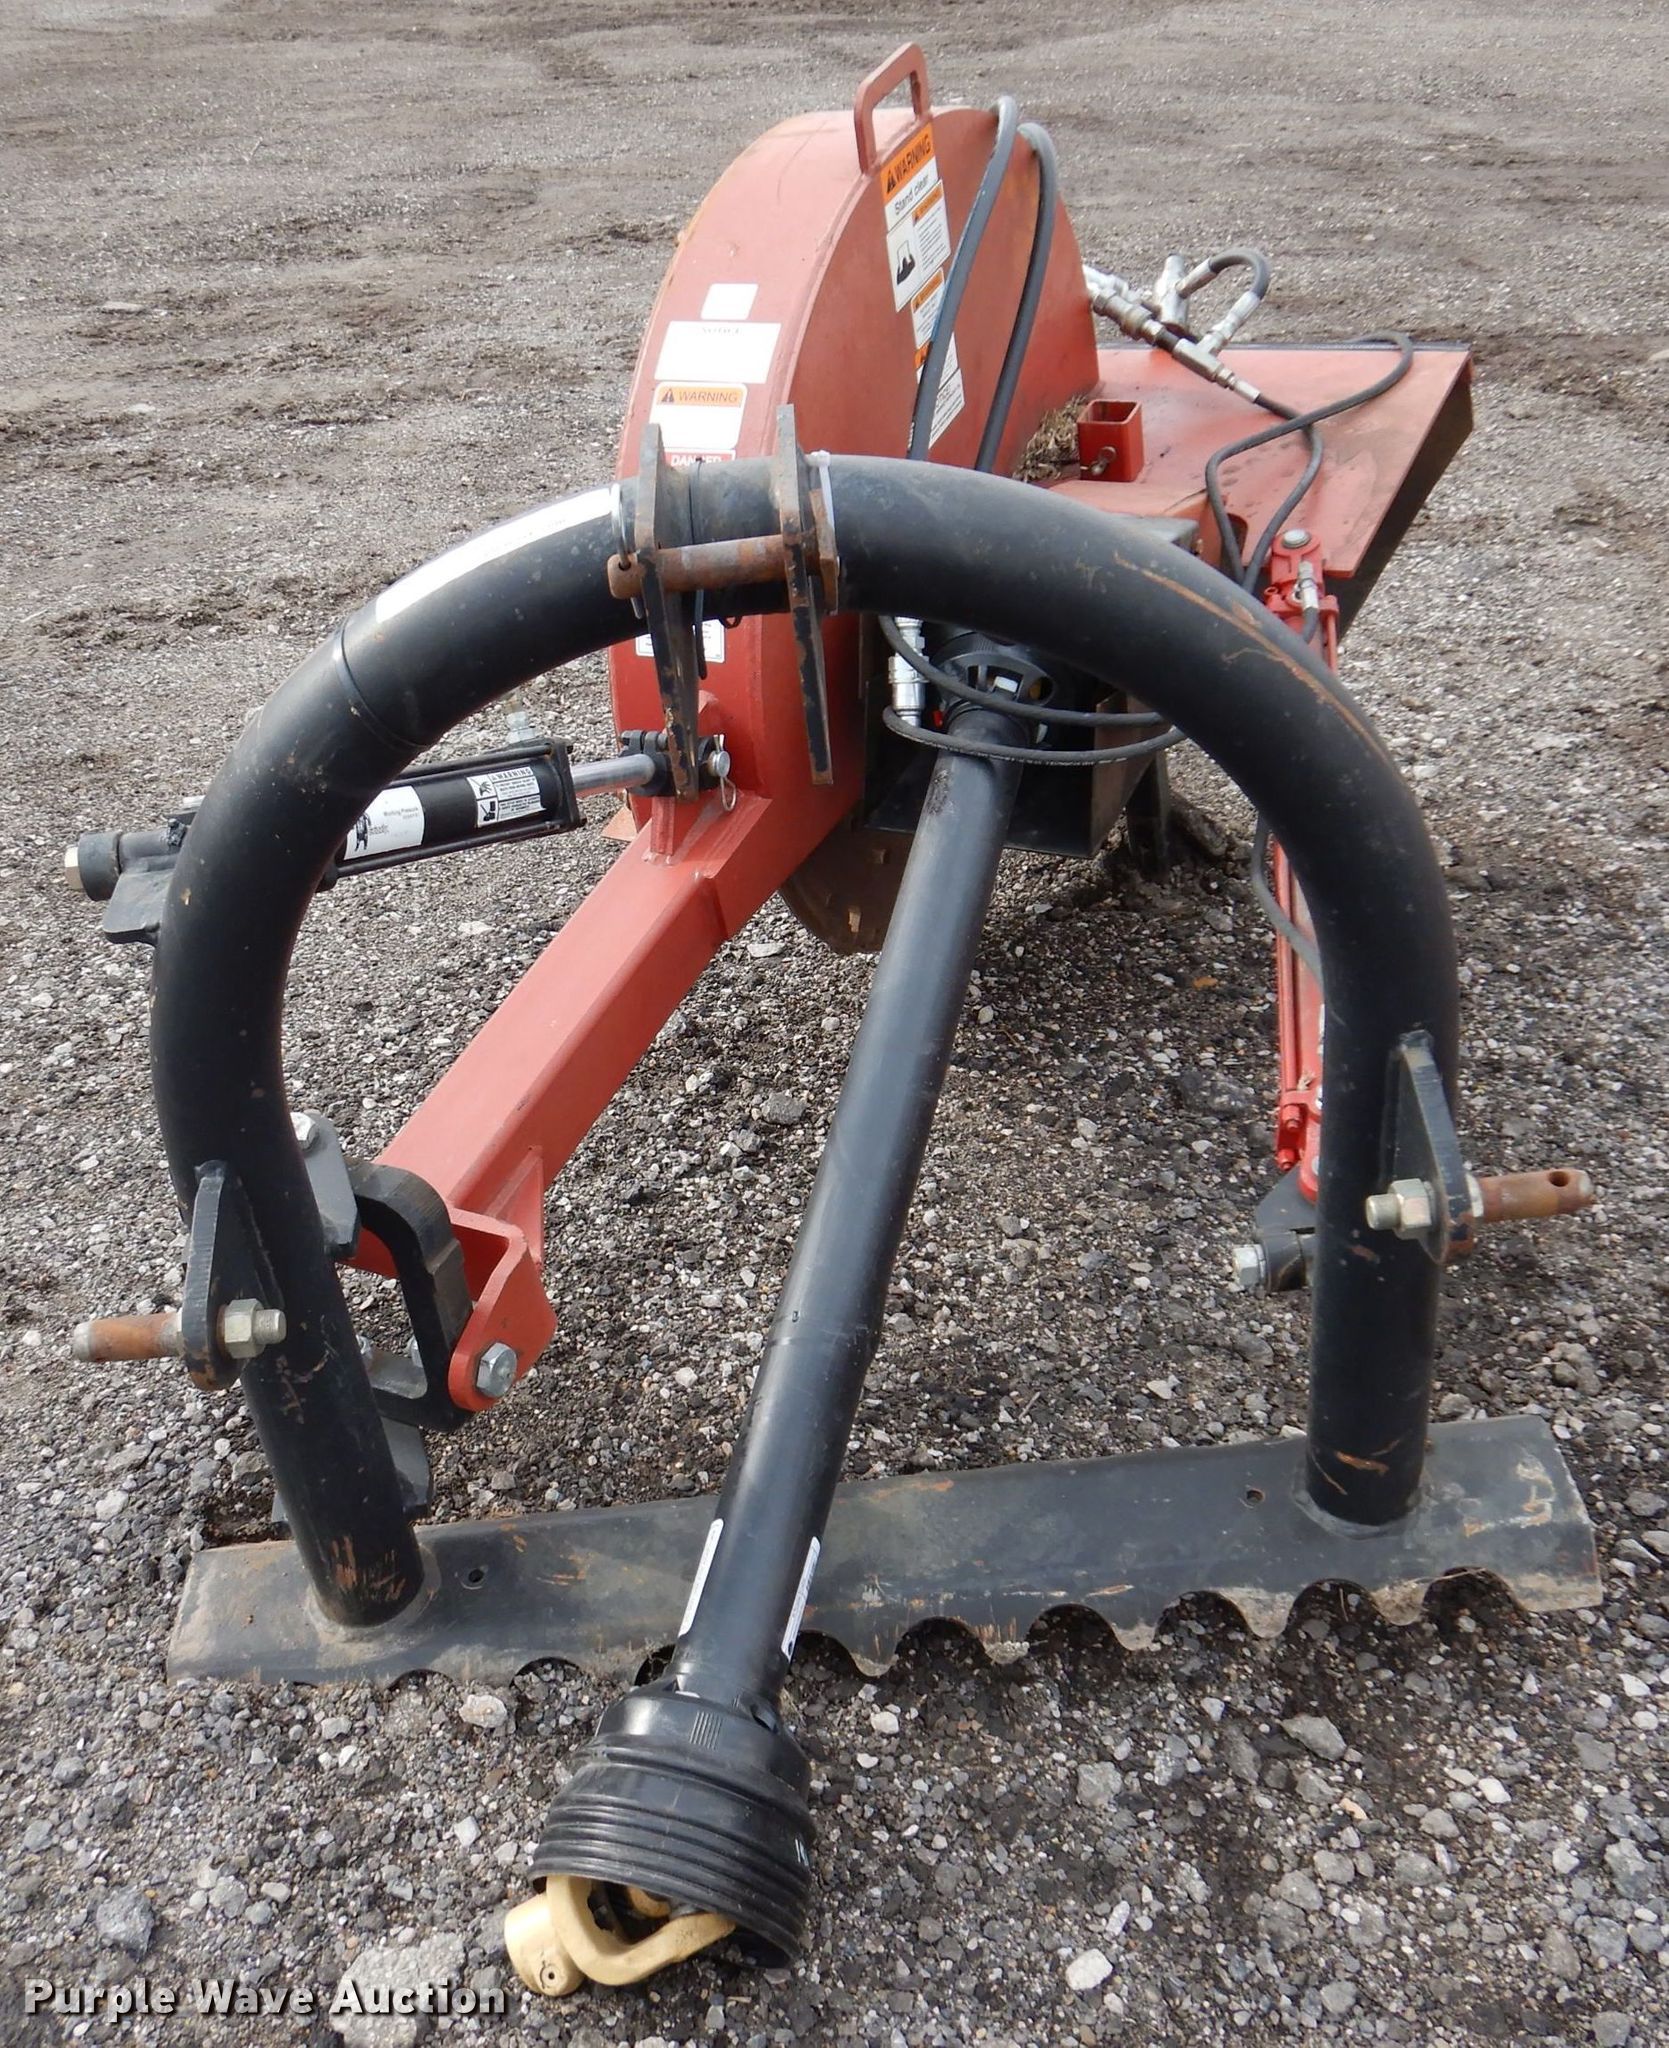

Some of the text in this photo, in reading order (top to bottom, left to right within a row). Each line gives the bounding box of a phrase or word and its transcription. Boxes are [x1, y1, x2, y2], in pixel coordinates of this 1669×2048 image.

[893, 133, 931, 184] WARNING
[894, 187, 913, 216] Stand
[678, 391, 738, 403] WARNING
